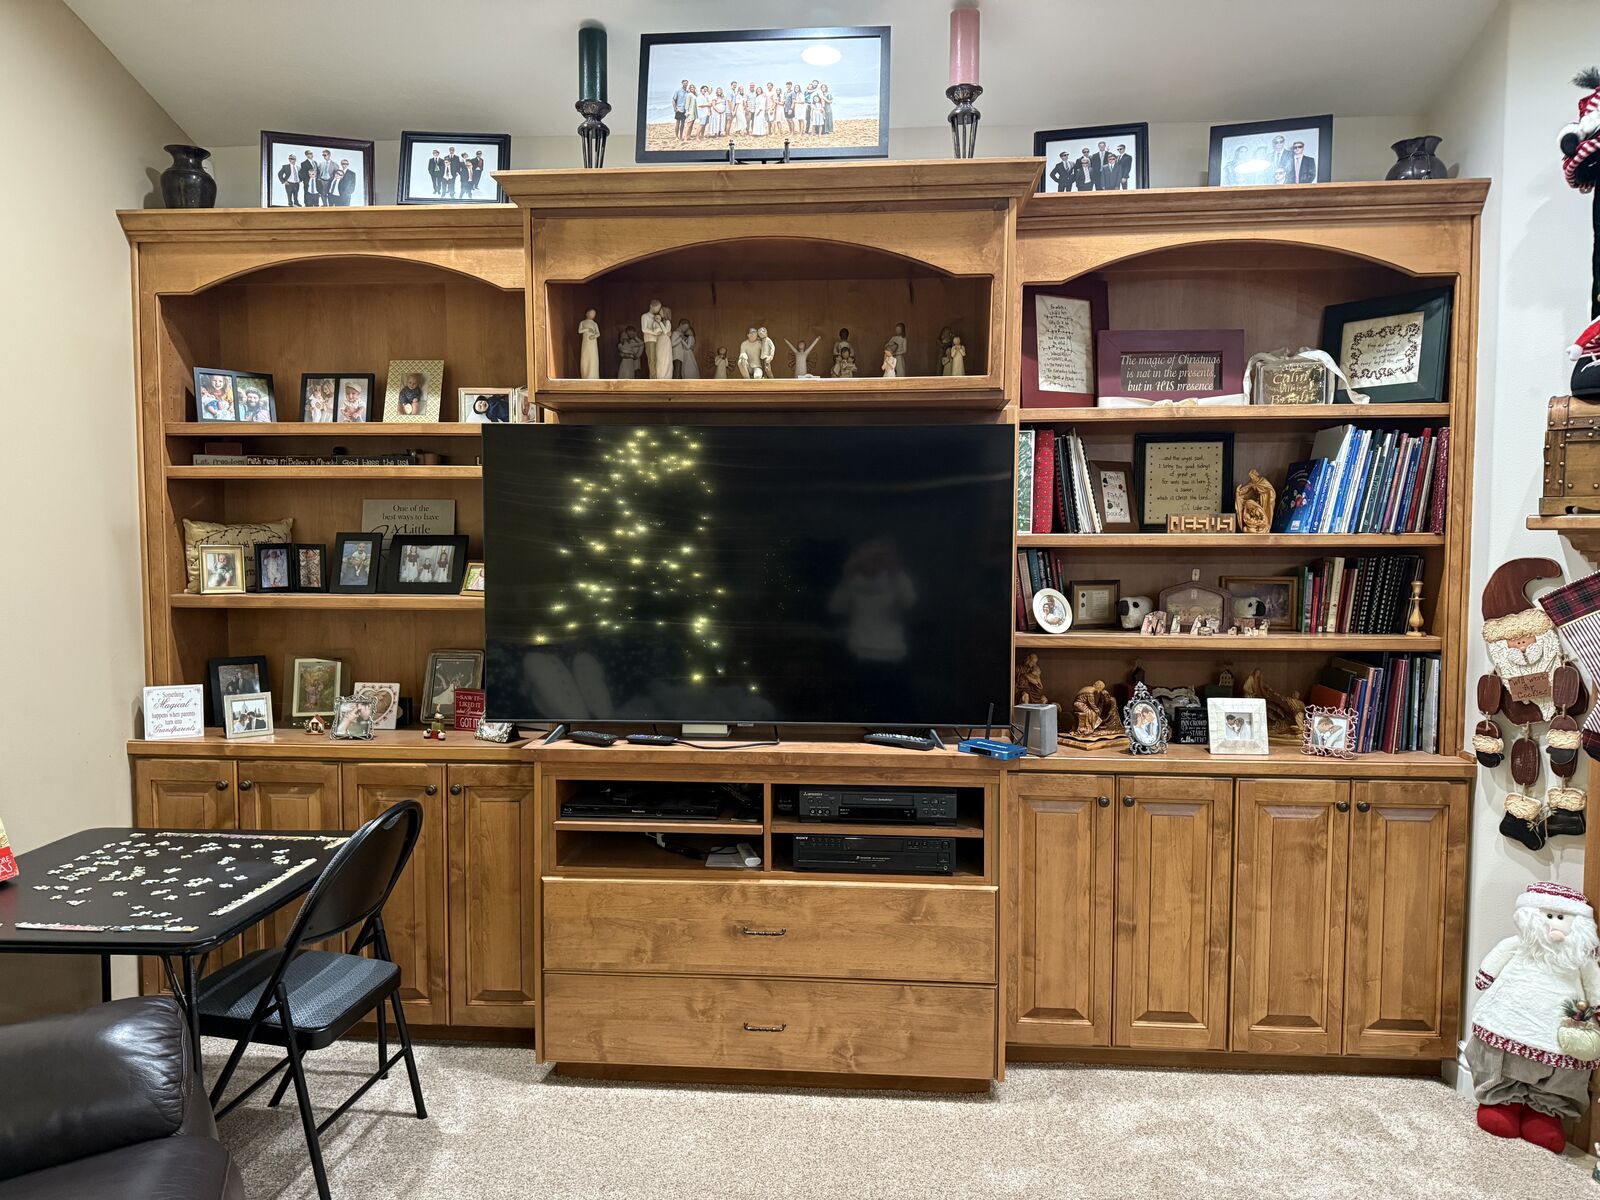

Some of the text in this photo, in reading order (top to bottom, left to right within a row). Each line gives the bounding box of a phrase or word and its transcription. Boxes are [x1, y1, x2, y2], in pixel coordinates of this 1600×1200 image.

[1121, 353, 1220, 367] The magic of Christmas
[1126, 366, 1216, 380] is not in the presents,
[1127, 379, 1214, 391] but in HIS presence
[392, 504, 430, 512] One of the
[382, 512, 397, 520] best
[397, 513, 414, 521] ways
[423, 512, 440, 520] have
[403, 524, 431, 534] Little
[153, 698, 192, 712] Magical
[460, 717, 473, 728] GOT
[153, 724, 196, 734] Grandparents
